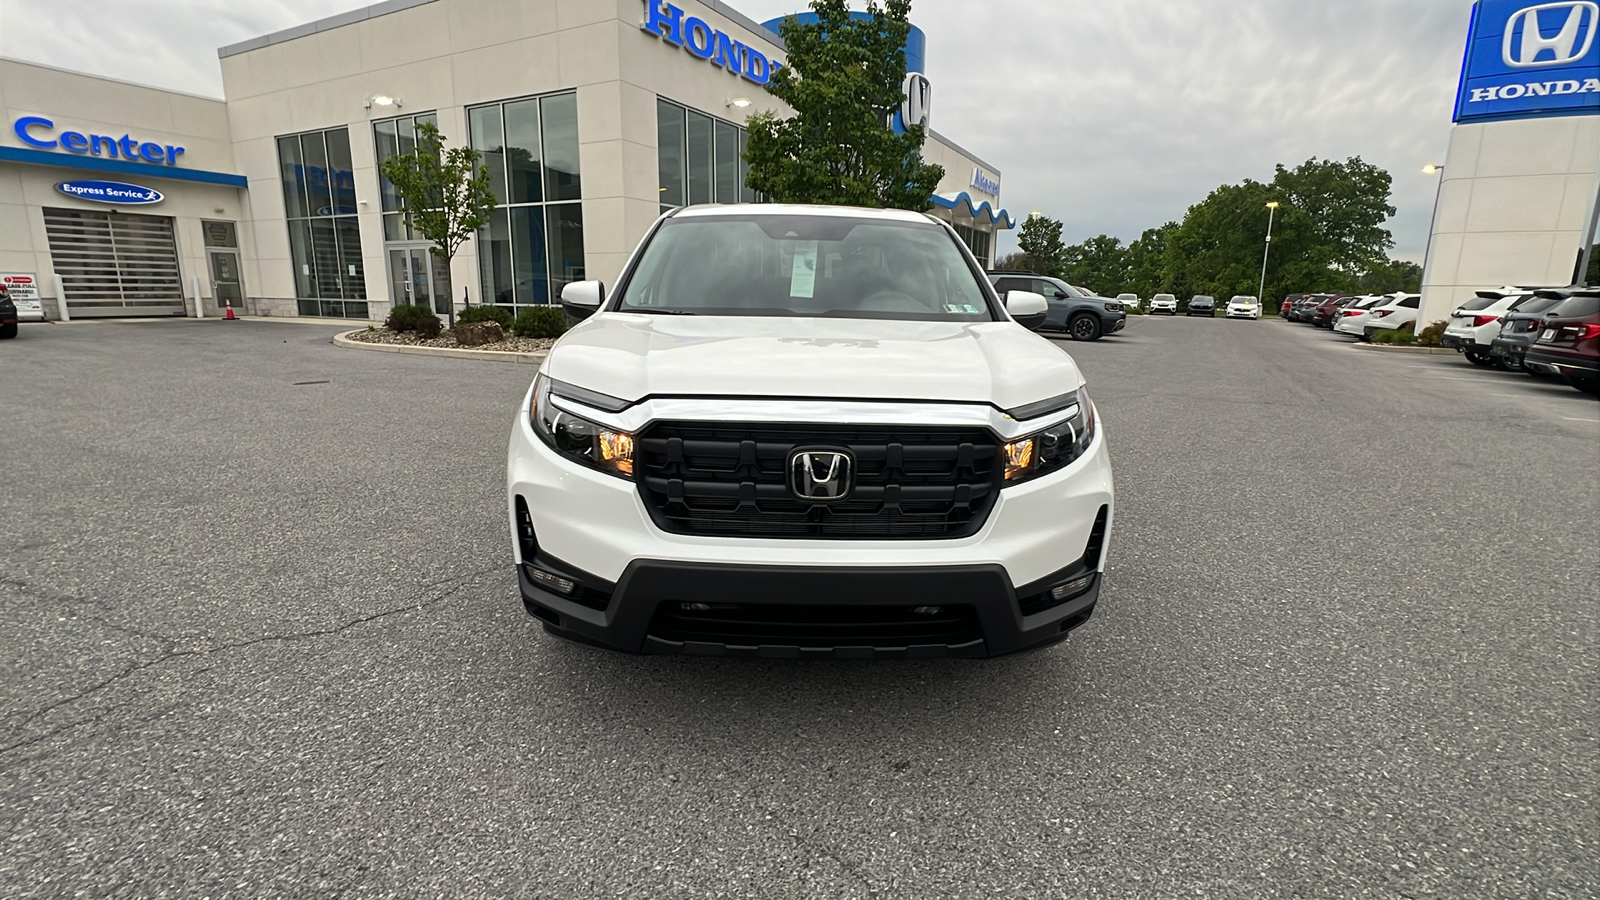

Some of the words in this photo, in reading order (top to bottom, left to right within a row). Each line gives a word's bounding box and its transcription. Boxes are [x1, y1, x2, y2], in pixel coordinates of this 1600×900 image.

[642, 0, 784, 87] HOND
[1469, 78, 1600, 102] HONDA
[14, 116, 185, 165] Center
[63, 184, 104, 195] Express
[106, 188, 143, 199] Service
